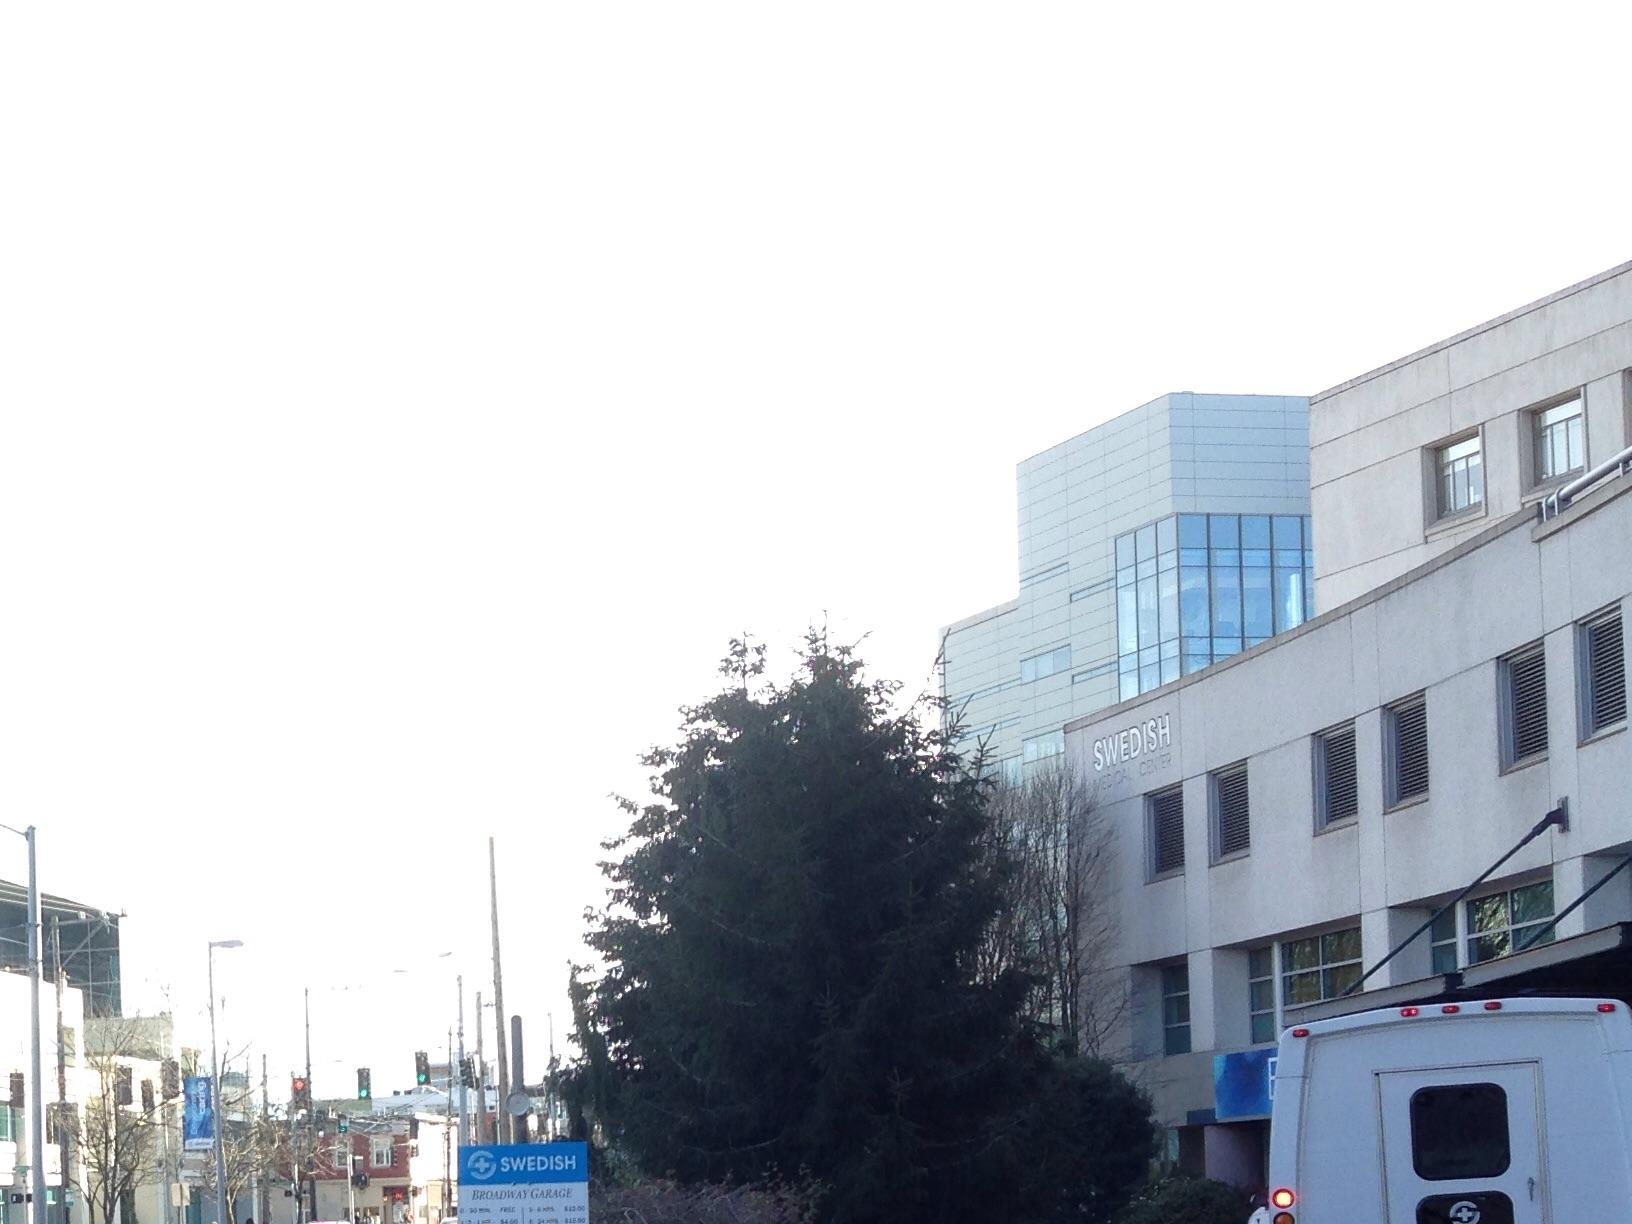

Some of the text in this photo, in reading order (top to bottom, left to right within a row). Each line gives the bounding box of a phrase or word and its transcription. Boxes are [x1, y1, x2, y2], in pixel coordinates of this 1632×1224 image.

[1094, 713, 1170, 771] SWEDISH
[499, 1155, 577, 1173] SWEDISH
[471, 1187, 574, 1201] BROADWAY GARAGE
